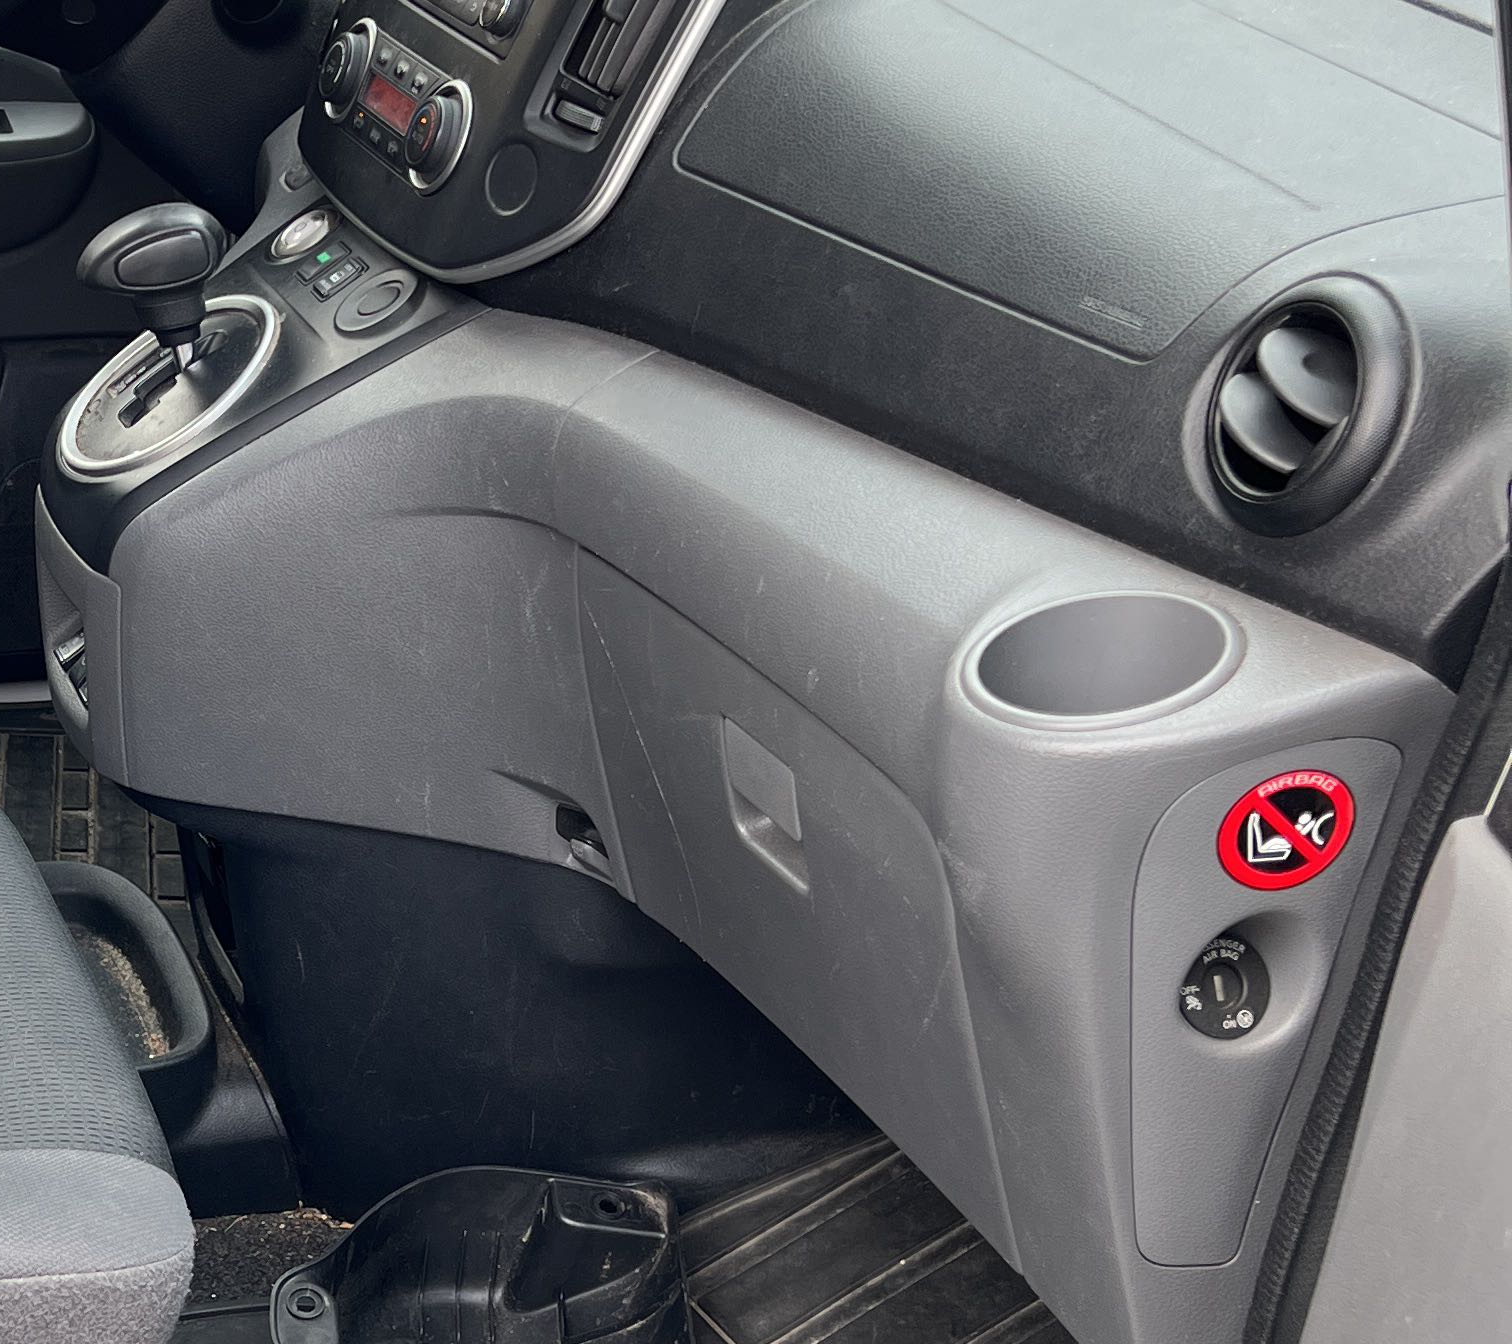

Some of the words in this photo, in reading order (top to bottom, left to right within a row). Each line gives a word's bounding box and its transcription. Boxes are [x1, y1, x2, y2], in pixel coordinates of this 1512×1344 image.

[1257, 774, 1337, 797] AIRBAG
[1219, 948, 1240, 961] BAG
[1222, 1019, 1237, 1030] ON
